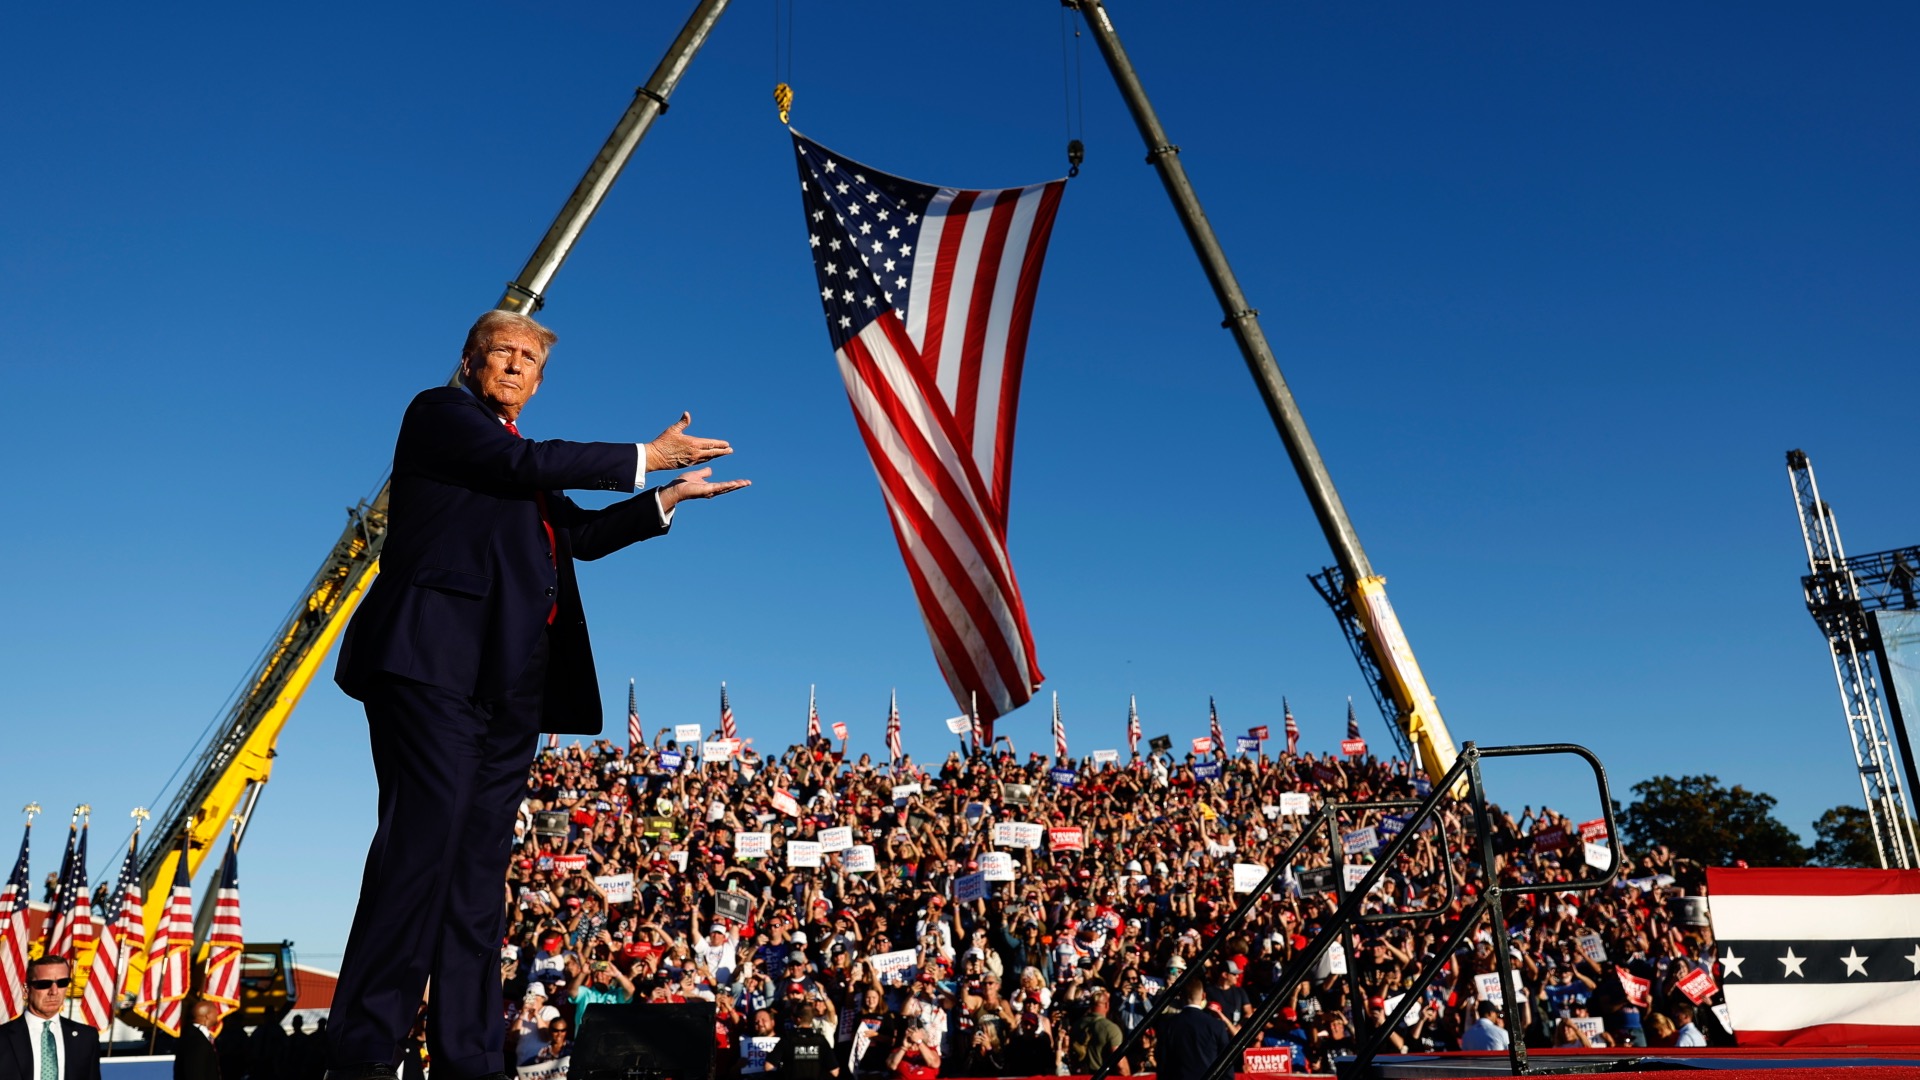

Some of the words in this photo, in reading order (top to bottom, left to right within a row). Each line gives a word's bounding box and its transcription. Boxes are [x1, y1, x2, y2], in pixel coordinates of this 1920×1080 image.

[555, 861, 586, 869] TRUMP
[599, 881, 630, 889] TRUMP
[880, 957, 910, 966] FIGHT!
[747, 1042, 776, 1050] FIGHT
[747, 1050, 767, 1058] FIG
[794, 1046, 819, 1055] POLICE
[747, 1059, 766, 1067] FIG
[1246, 1055, 1289, 1064] TRUMP
[1251, 1062, 1284, 1070] VANCE
[524, 1066, 569, 1077] TRUMP
